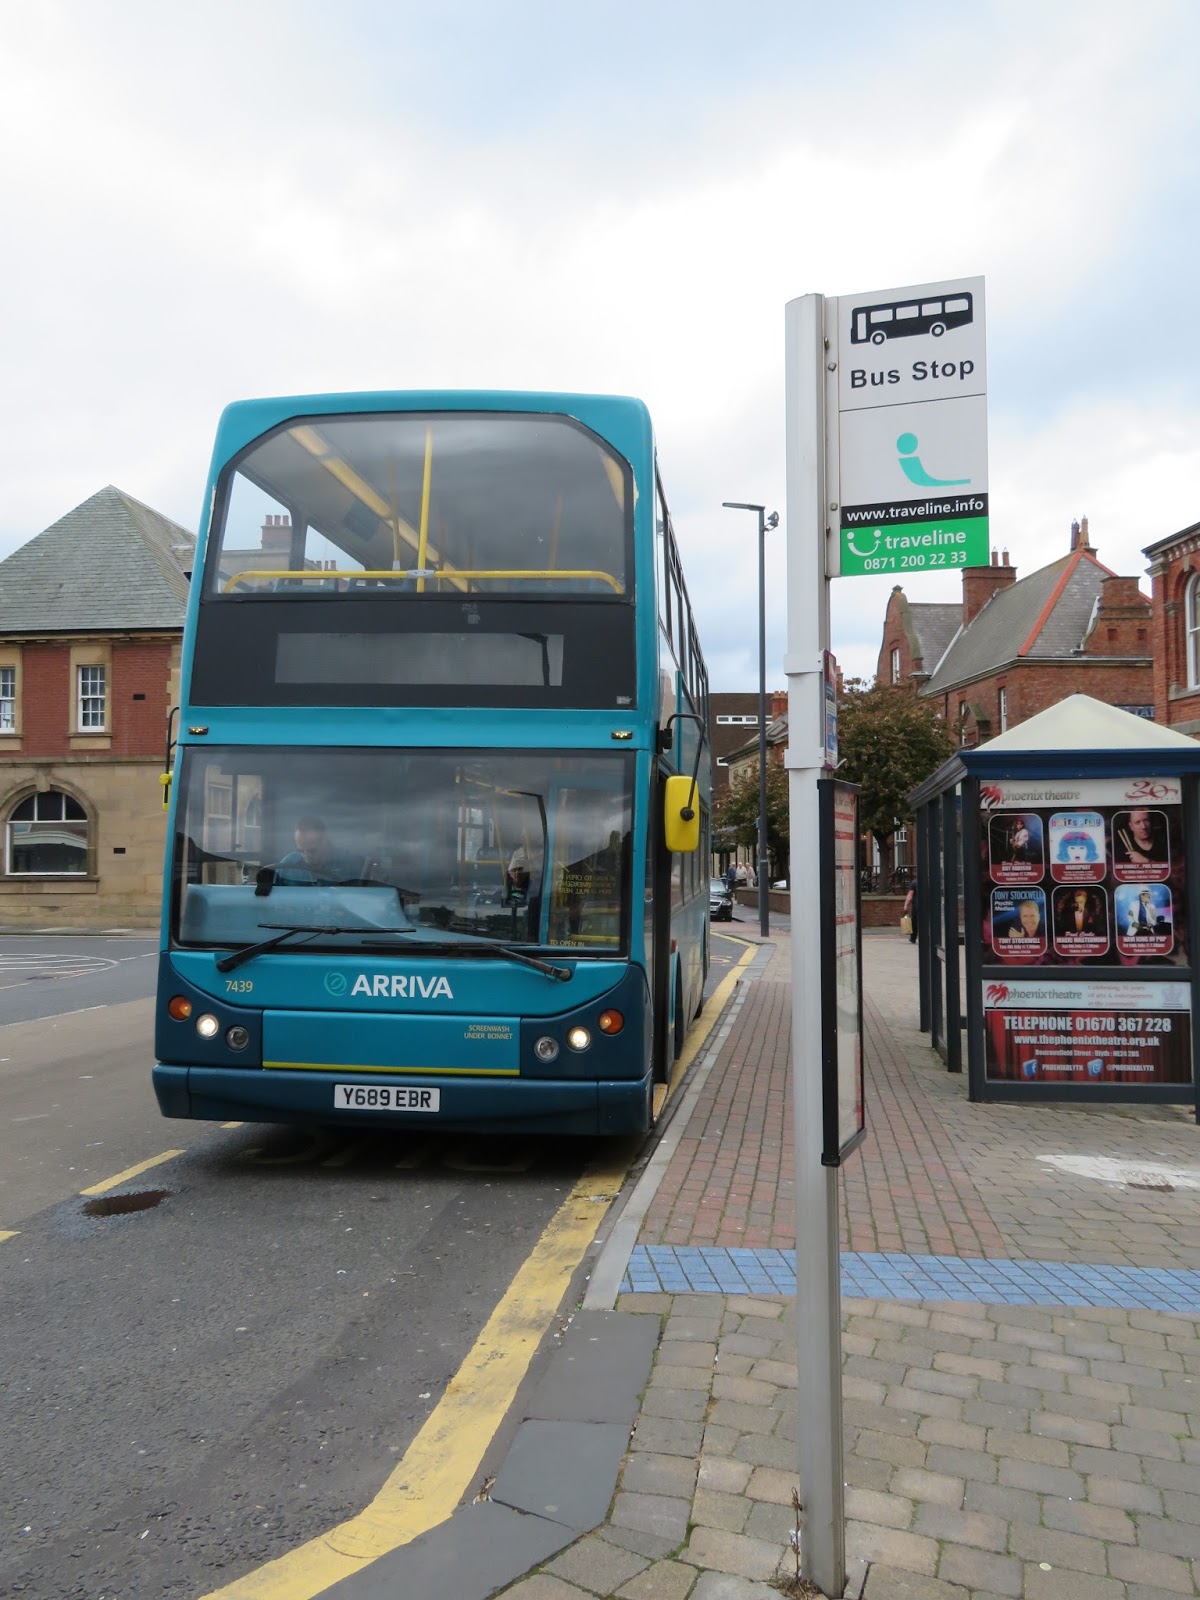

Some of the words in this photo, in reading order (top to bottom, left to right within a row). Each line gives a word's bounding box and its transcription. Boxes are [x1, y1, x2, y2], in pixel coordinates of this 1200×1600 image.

[850, 368, 901, 389] Bus
[912, 359, 975, 381] Stop
[846, 498, 984, 522] www.traveline.info
[885, 529, 966, 550] traveline
[864, 557, 896, 570] 0871
[900, 555, 925, 568] 200
[930, 553, 946, 566] 22
[950, 551, 967, 564] 33
[1002, 790, 1044, 804] phoenix
[1044, 790, 1080, 800] theatre
[994, 891, 1009, 900] TONY
[225, 980, 253, 992] 7439
[351, 974, 454, 998] ARRIVA
[1008, 988, 1046, 1002] phoenix
[1048, 990, 1082, 1000] theatre
[1004, 1016, 1073, 1030] TELEPHONE
[1076, 1017, 1115, 1031] 01670
[1118, 1018, 1142, 1031] 367
[1145, 1018, 1172, 1032] 228
[1014, 1035, 1160, 1046] www.thephoenixtheatre.org.uk
[343, 1088, 390, 1106] Y689
[396, 1090, 431, 1108] EBR
